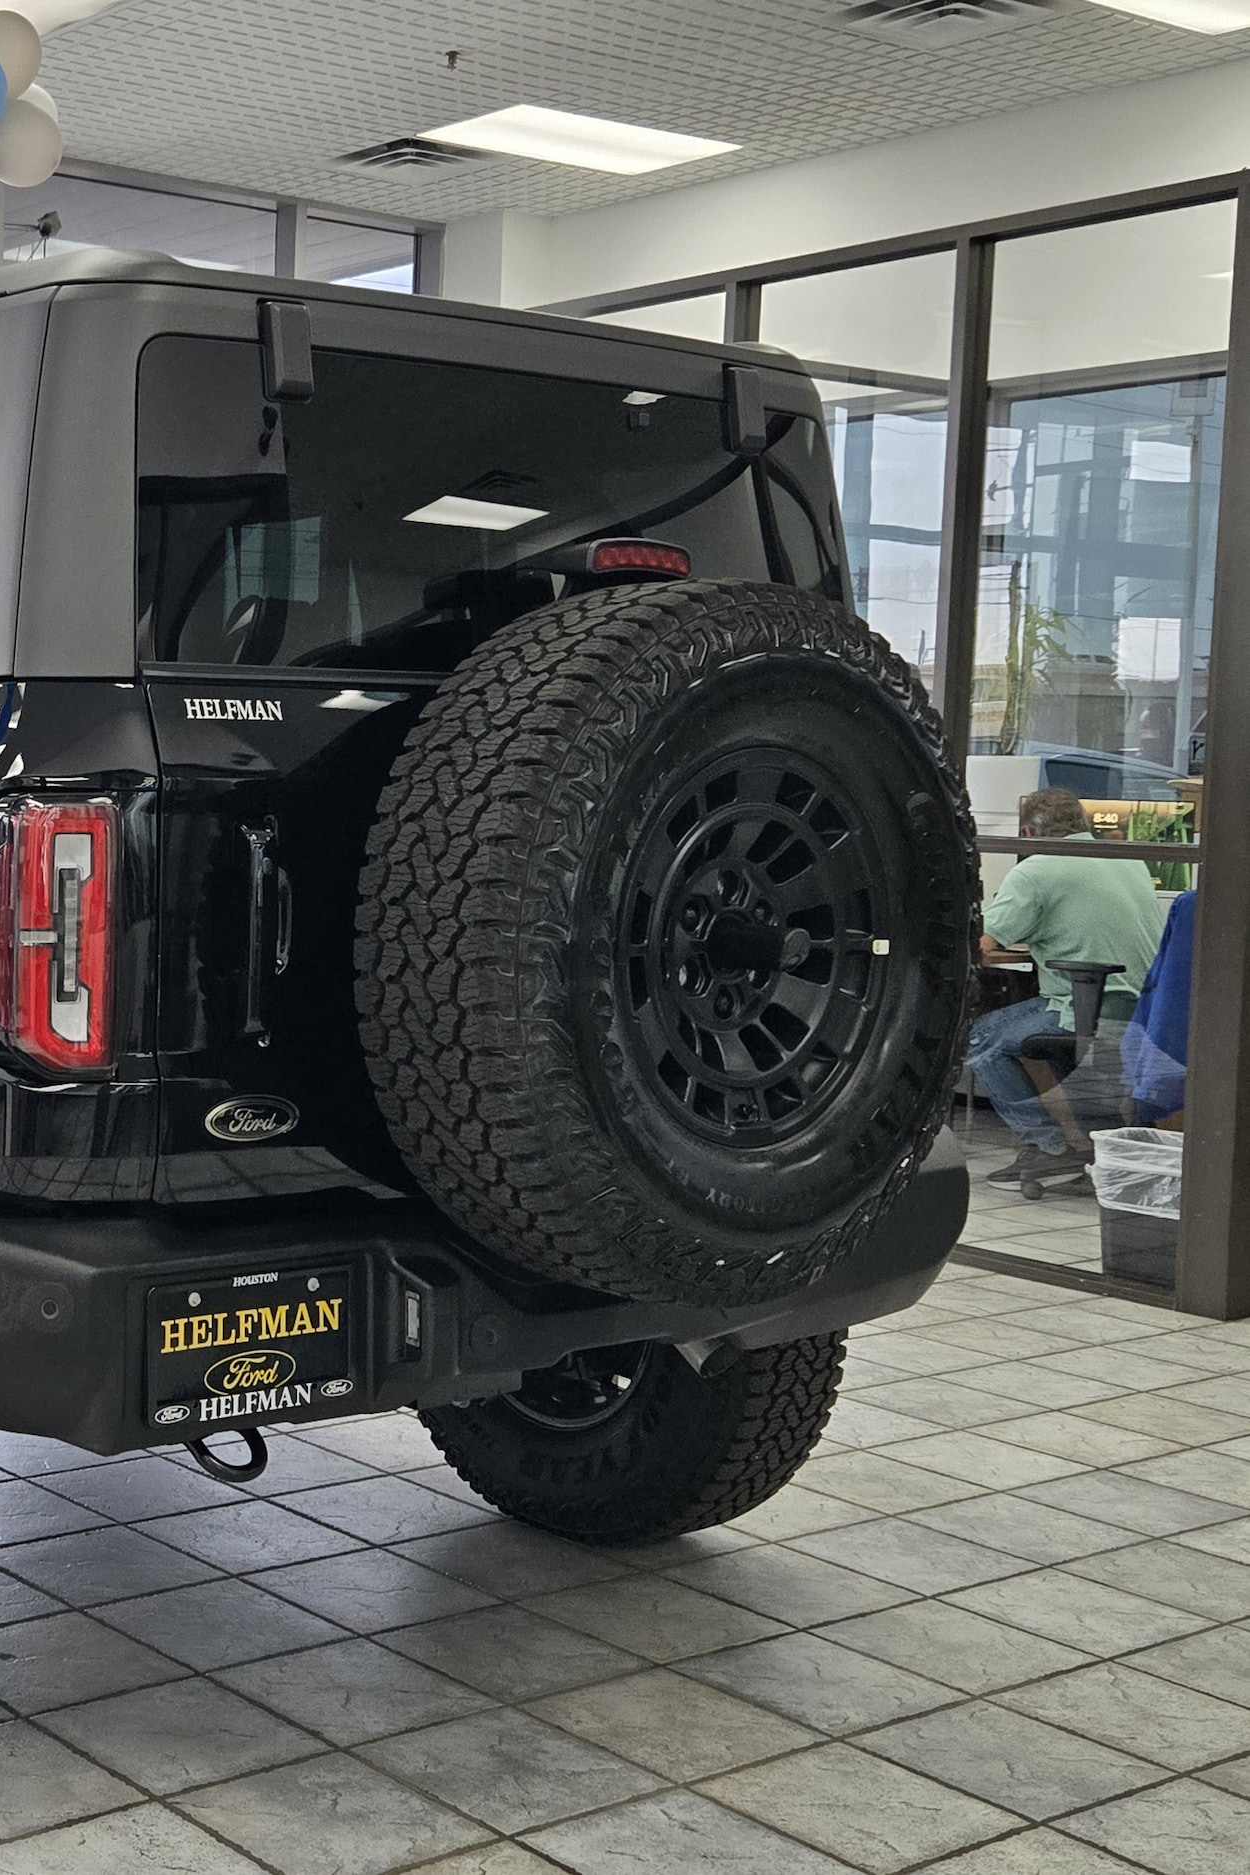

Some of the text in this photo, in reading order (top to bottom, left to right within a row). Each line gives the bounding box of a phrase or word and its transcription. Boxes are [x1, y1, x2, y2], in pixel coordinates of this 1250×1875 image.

[184, 698, 283, 721] HELFMAN
[1093, 812, 1119, 824] 8:40
[228, 1108, 277, 1133] Ford
[232, 1272, 279, 1288] HOUSTON
[160, 1298, 343, 1354] HELFMAN
[222, 1355, 280, 1390] Ford
[199, 1382, 313, 1421] HELFMAN
